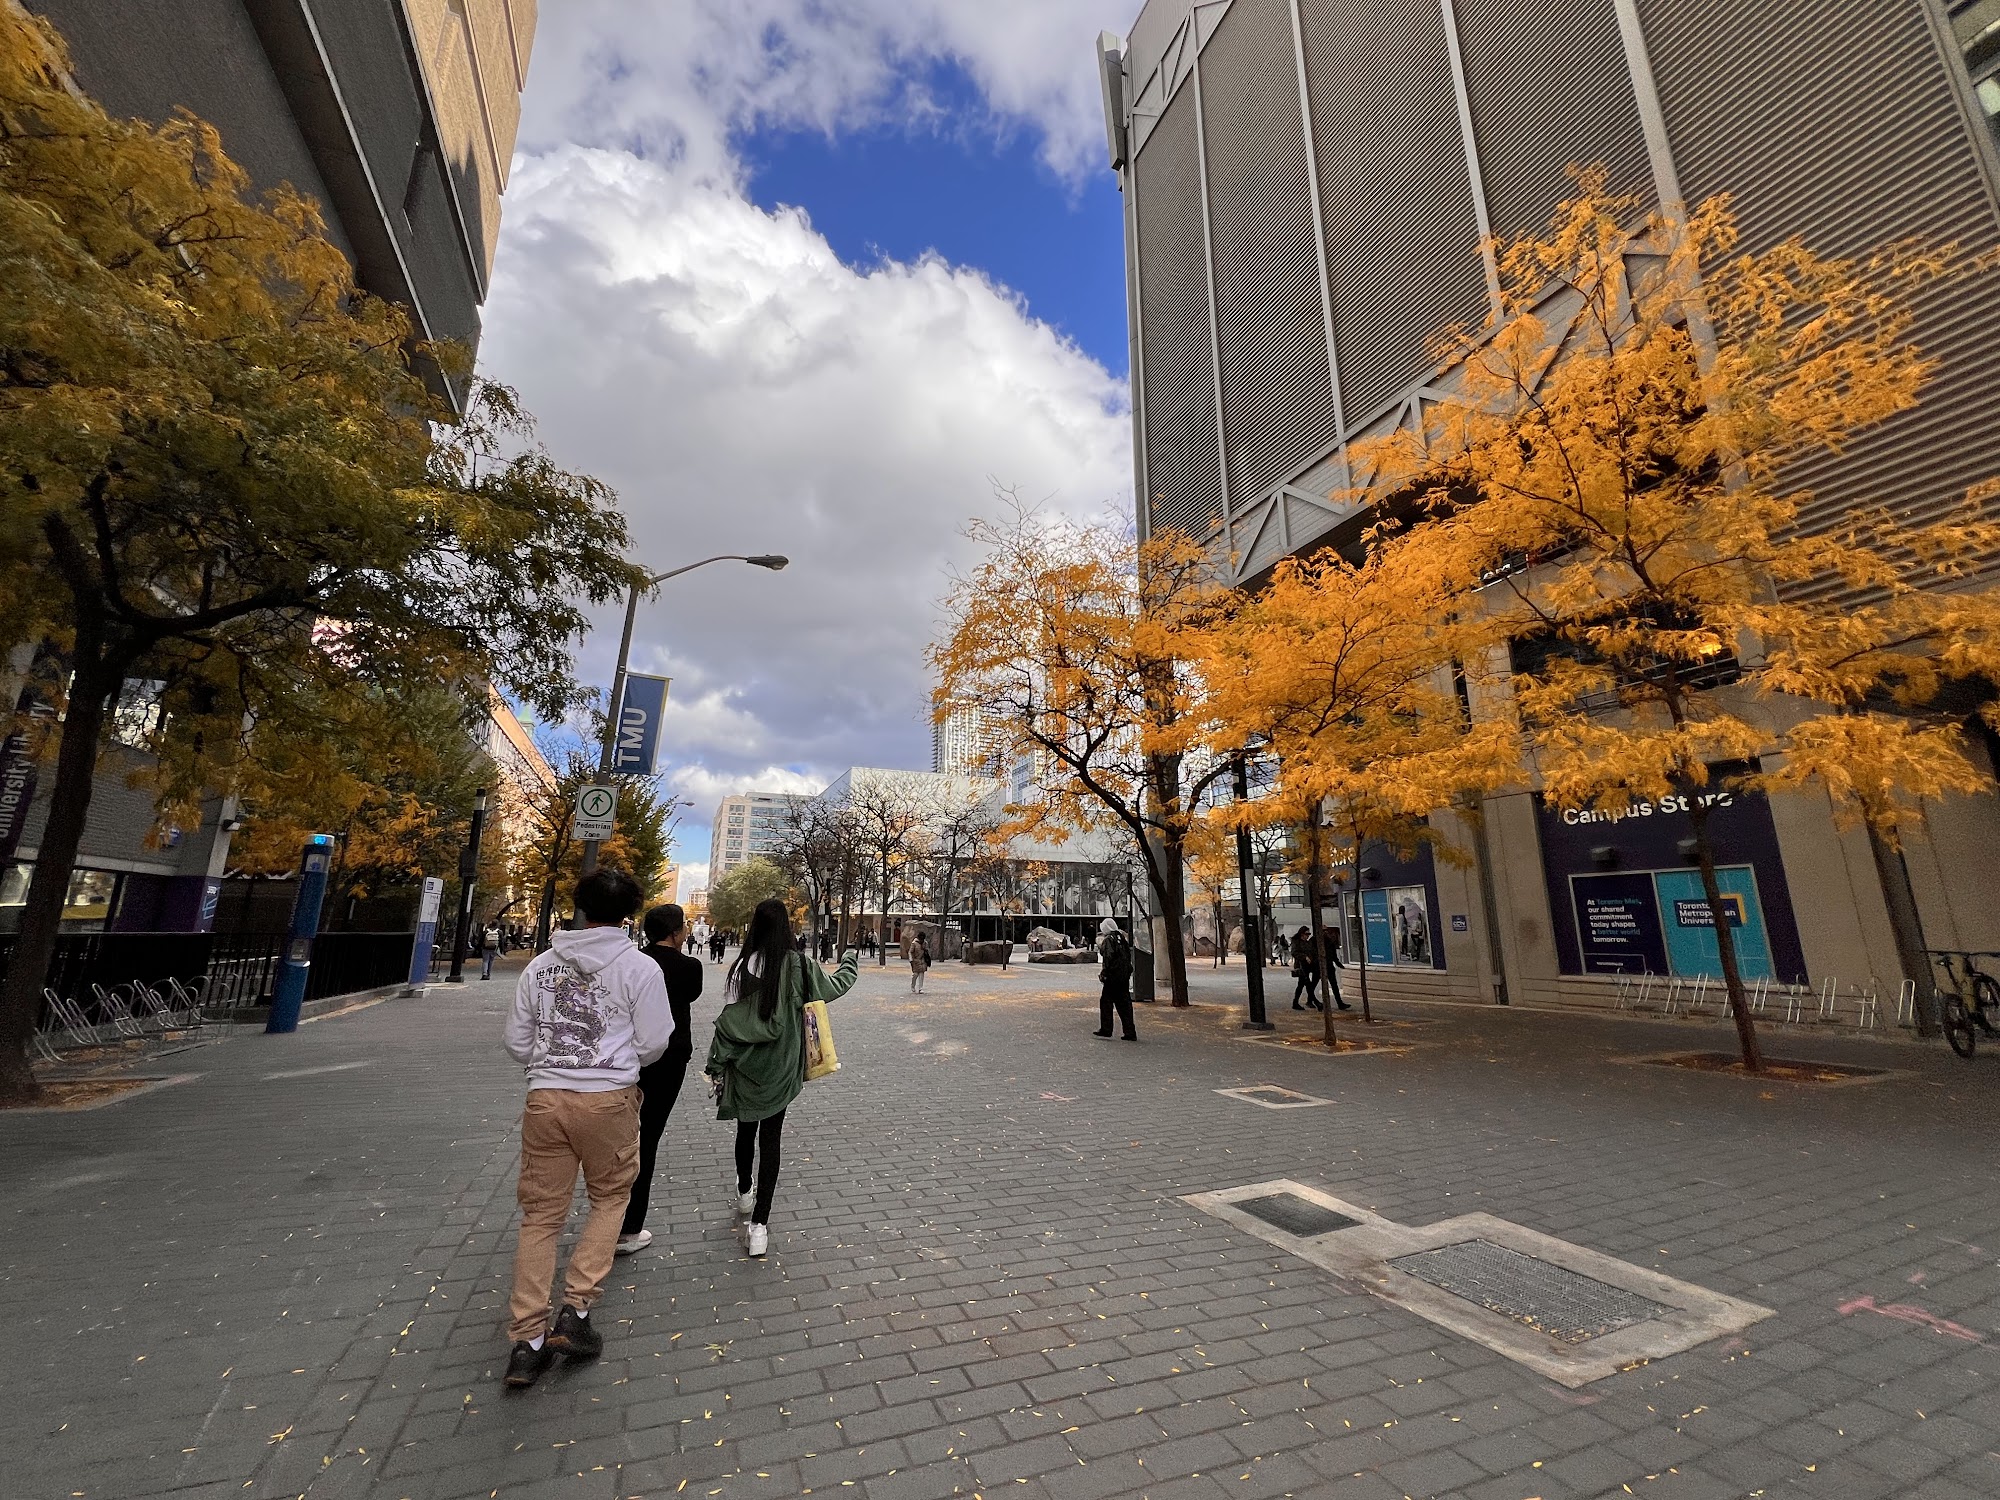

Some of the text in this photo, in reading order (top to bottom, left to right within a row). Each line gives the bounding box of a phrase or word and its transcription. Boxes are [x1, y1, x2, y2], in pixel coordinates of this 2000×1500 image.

[617, 708, 647, 766] TMU
[1660, 793, 1733, 813] Stre
[576, 822, 611, 830] Pedestrian
[1679, 910, 1736, 918] Metropan
